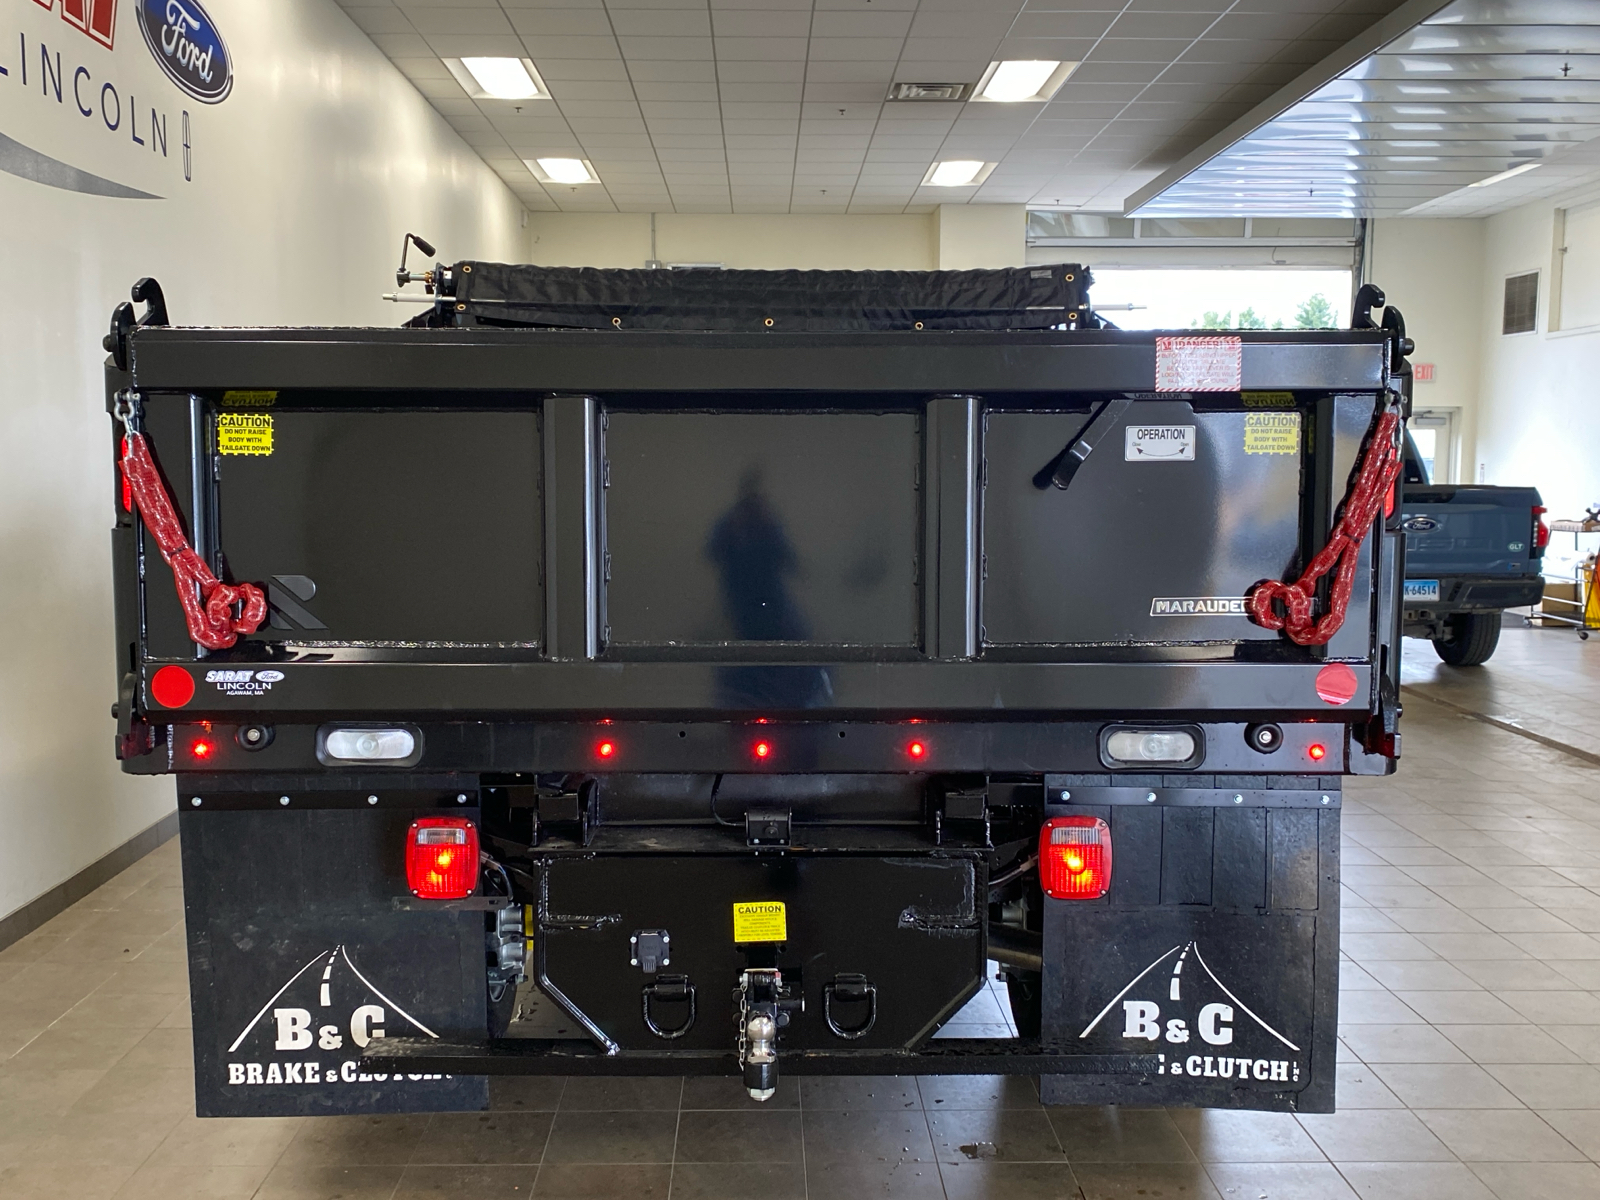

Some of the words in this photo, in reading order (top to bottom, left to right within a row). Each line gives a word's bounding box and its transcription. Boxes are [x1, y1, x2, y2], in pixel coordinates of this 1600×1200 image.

[161, 0, 213, 84] Ford
[1415, 364, 1435, 380] EXIT
[220, 416, 271, 427] CAUTION
[1247, 416, 1297, 427] CAUTION
[1136, 428, 1186, 440] OPERATION
[1155, 600, 1246, 613] MARAUDE
[205, 670, 254, 683] SARAT
[216, 682, 272, 690] LINCOLN
[738, 905, 781, 914] CAUTION
[228, 1062, 320, 1085] BRAKE
[1186, 1055, 1289, 1082] CLUTCH
